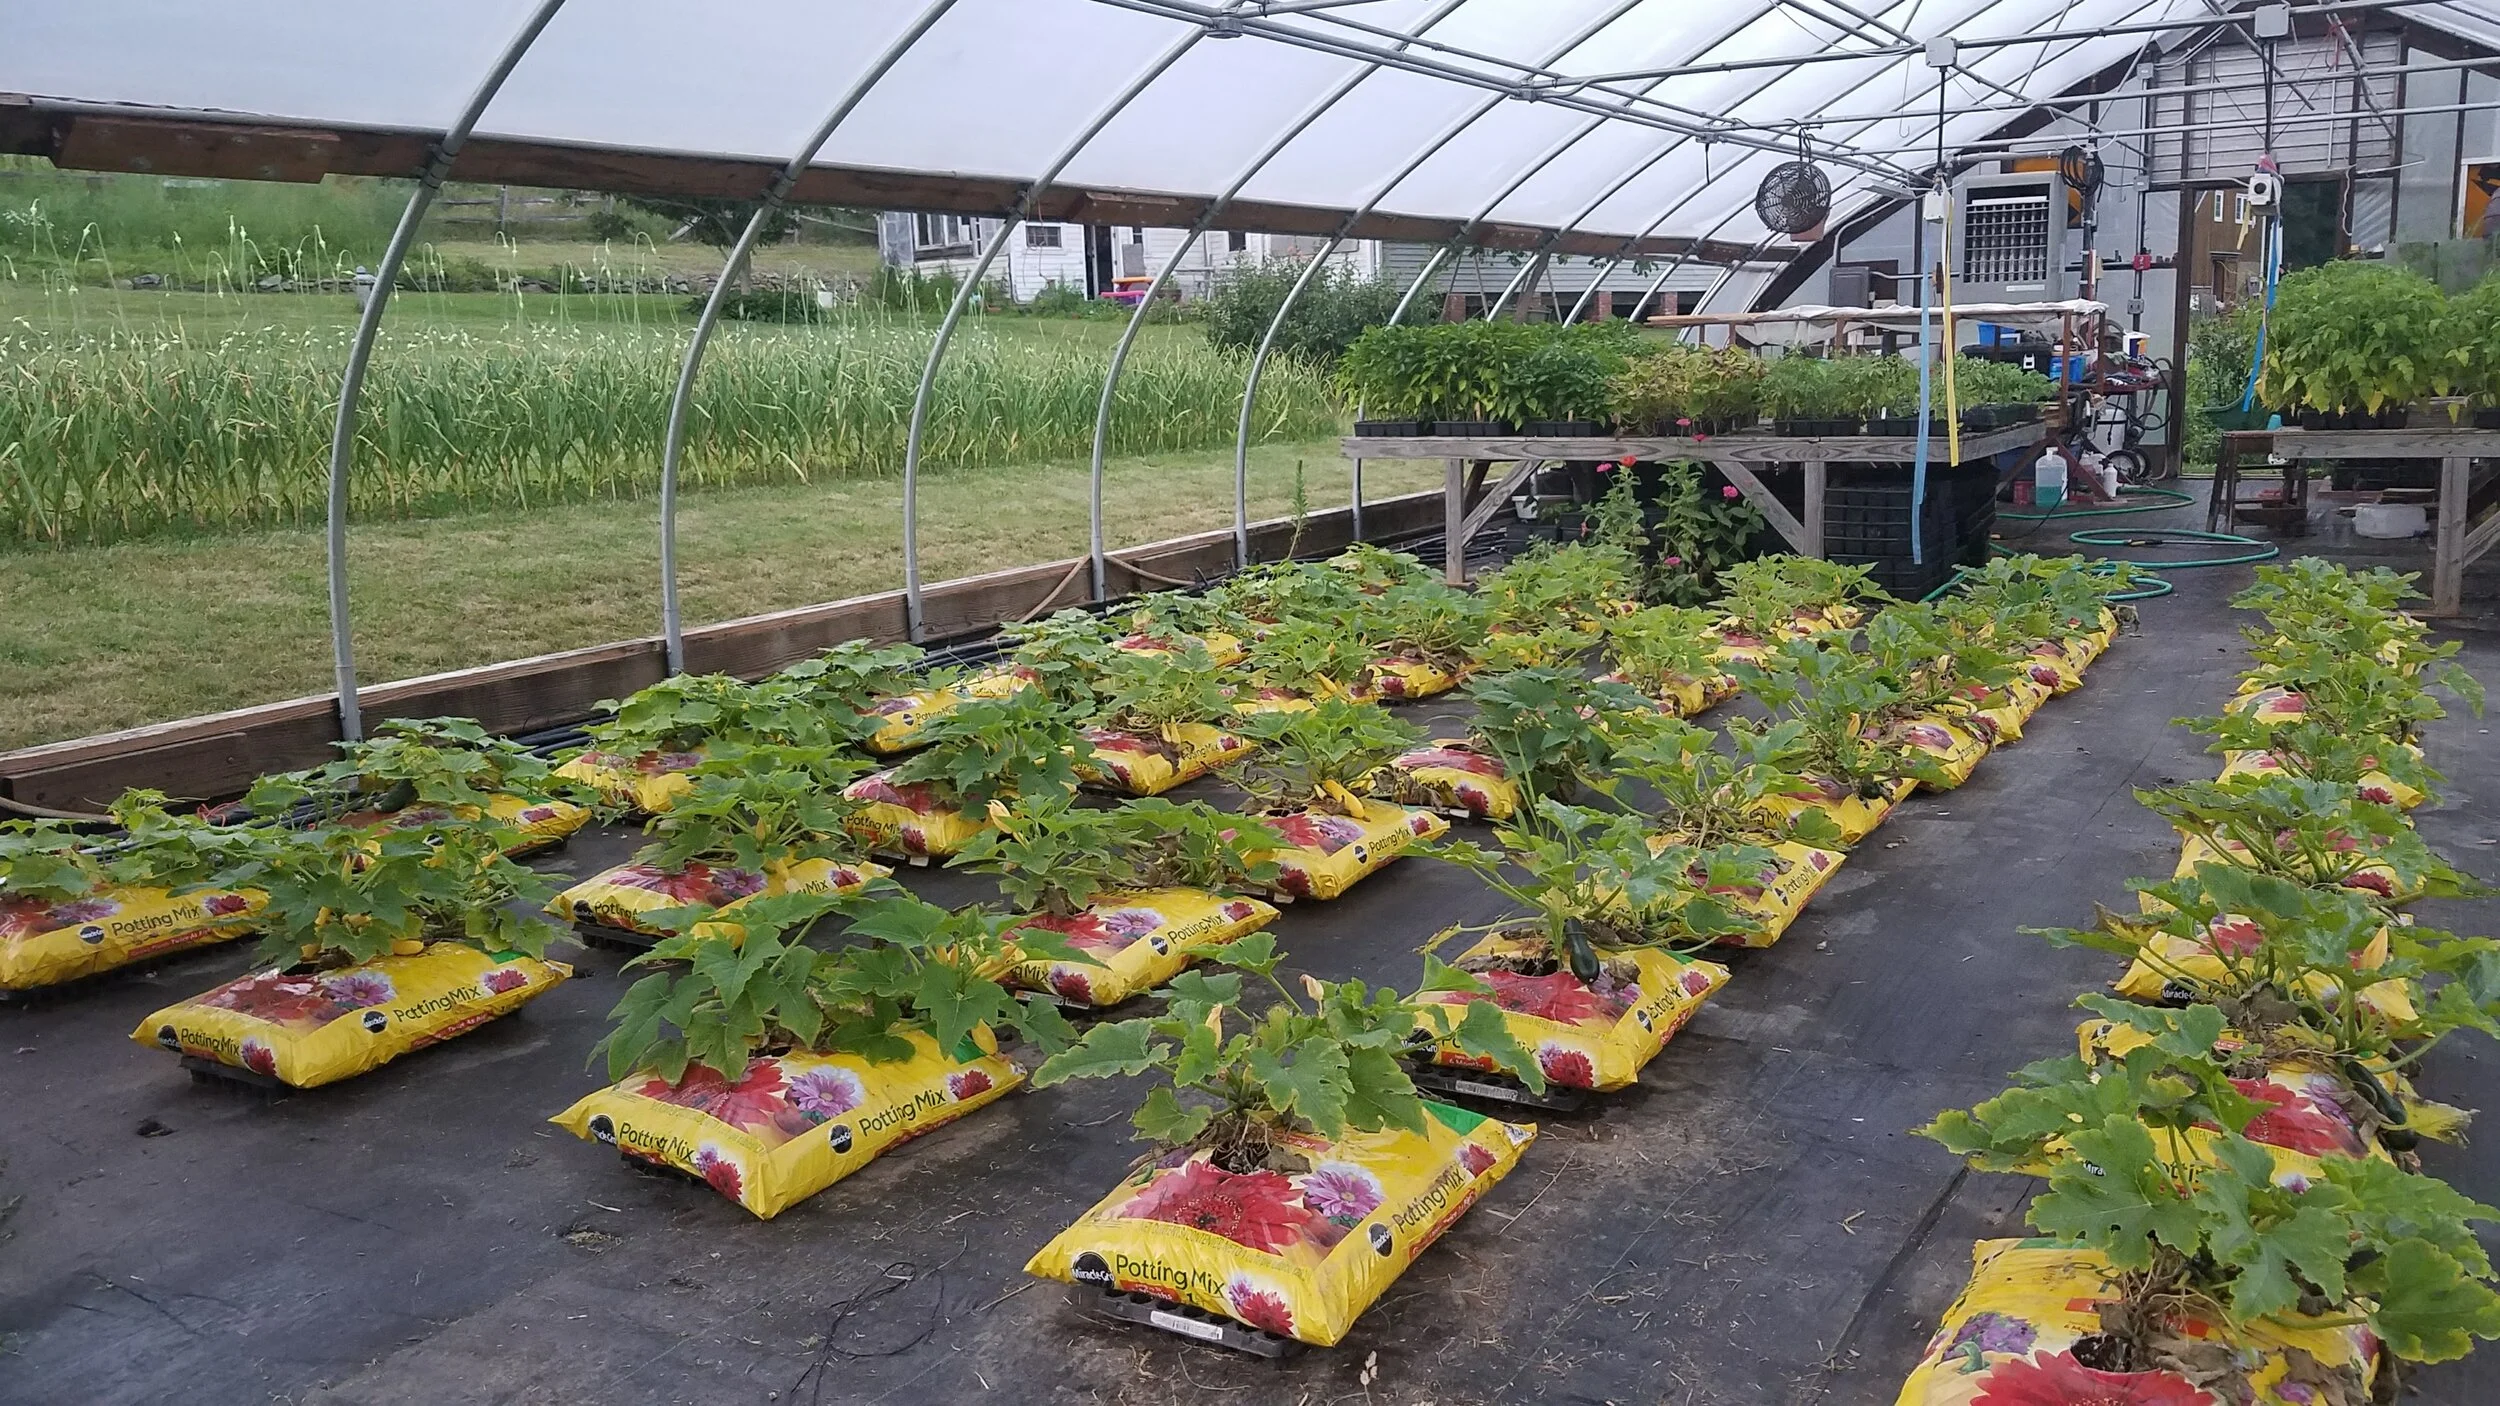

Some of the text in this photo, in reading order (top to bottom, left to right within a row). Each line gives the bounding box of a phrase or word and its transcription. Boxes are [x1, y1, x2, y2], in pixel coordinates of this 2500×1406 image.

[1369, 827, 1411, 854] Potting Mix
[805, 879, 828, 895] Mix
[111, 915, 173, 937] Potting
[172, 905, 200, 921] Mix
[1167, 914, 1226, 945] Potting Mix
[1025, 964, 1049, 982] Mix
[393, 996, 452, 1022] Potting
[448, 986, 481, 1004] Mix
[181, 1028, 220, 1052] Potting
[220, 1036, 240, 1056] Mix
[858, 1101, 917, 1137] Potting
[914, 1089, 946, 1111] Mix
[619, 1122, 668, 1153] Potting
[667, 1136, 695, 1161] Mix
[1391, 1188, 1447, 1234] Potting
[1442, 1167, 1465, 1196] Mix
[1116, 1254, 1225, 1298] Potting Mix
